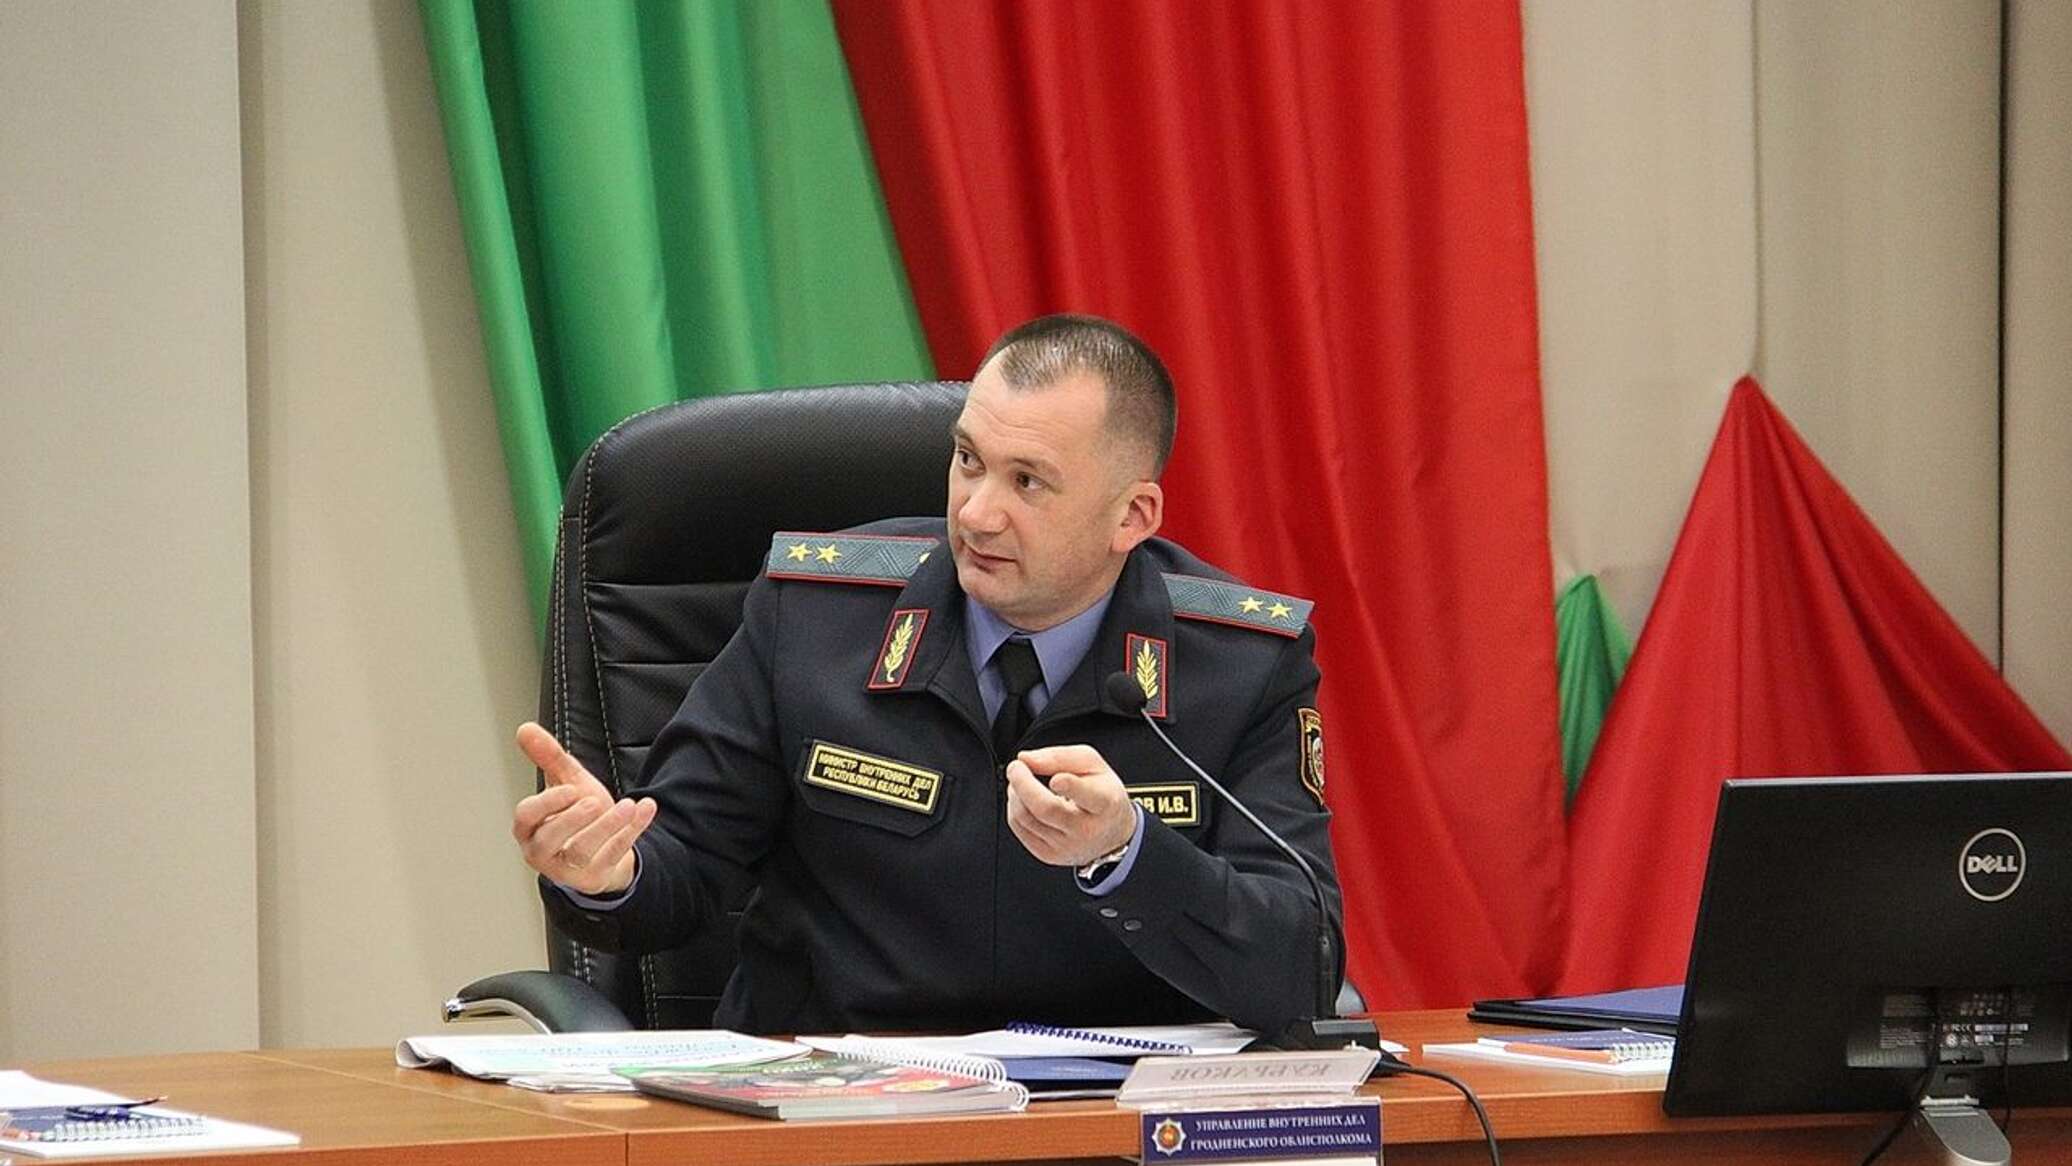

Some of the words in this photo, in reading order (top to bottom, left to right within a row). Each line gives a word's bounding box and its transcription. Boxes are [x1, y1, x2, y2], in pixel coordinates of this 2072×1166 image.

[818, 752, 858, 769] МИНИСТР
[912, 776, 932, 790] ДЕЛ
[877, 779, 920, 799] БЕЛАРУСЬ
[1158, 796, 1189, 814] И.В.
[1967, 855, 2018, 874] DELL
[1196, 1118, 1266, 1132] УПРАВЛЕНИЕ
[1268, 1115, 1344, 1129] ВНУТРЕННИХ
[1343, 1113, 1366, 1125] ДЕЛ
[1190, 1137, 1278, 1151] ГРОДНЕНСКОГО
[1279, 1134, 1373, 1148] ОБЛИСПОЛКОМА
